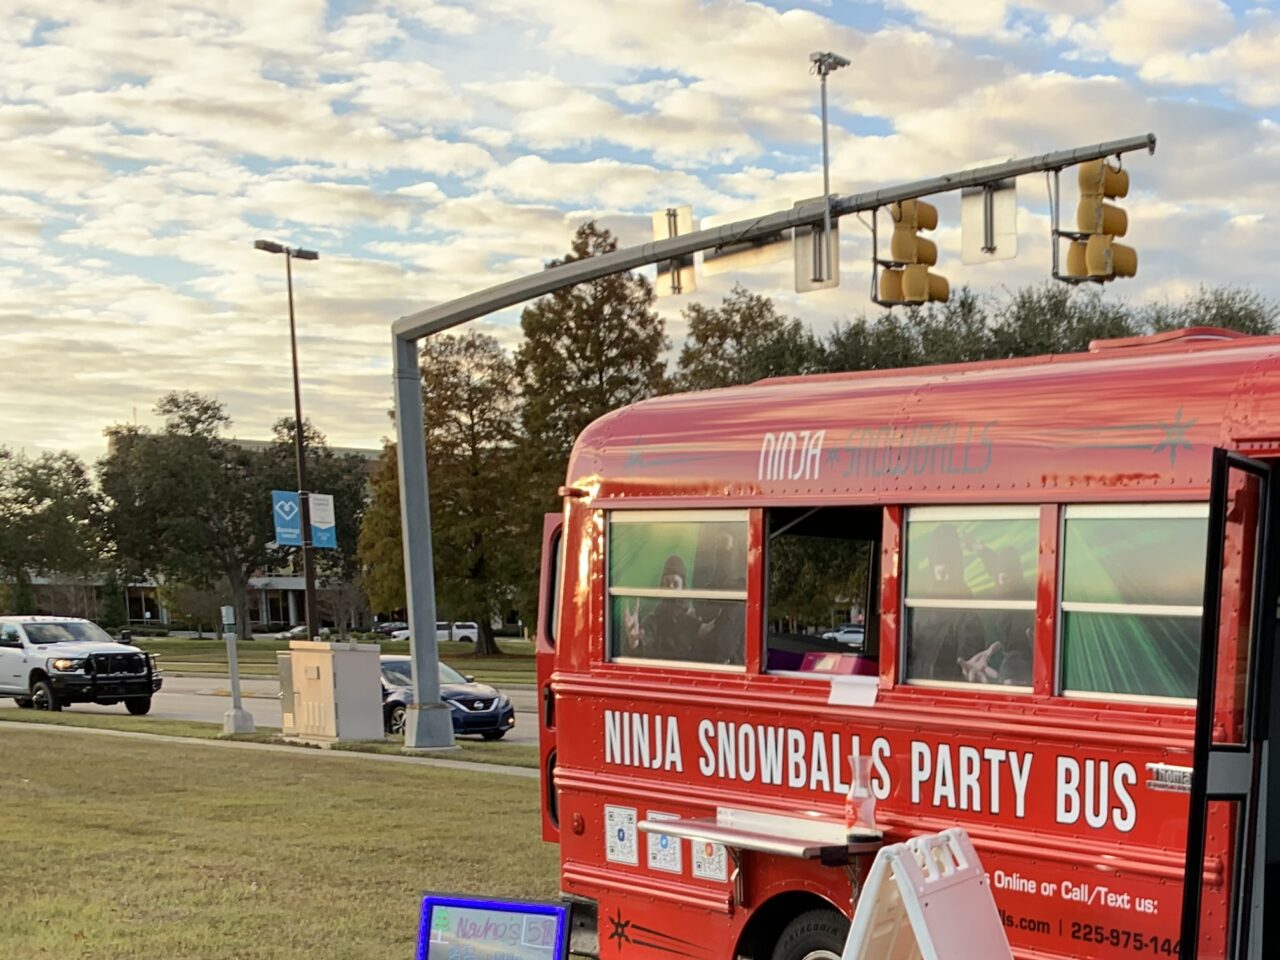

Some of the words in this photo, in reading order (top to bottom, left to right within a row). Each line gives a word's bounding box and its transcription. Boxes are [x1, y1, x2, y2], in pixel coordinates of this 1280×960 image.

[758, 429, 827, 481] NINJA
[841, 420, 998, 479] SNOWBALLS
[604, 709, 684, 773] NINJA
[698, 718, 892, 800] SNOWBALLS
[909, 740, 1034, 819] PARTY
[1055, 755, 1138, 833] BUS
[994, 870, 1037, 894] Online
[1041, 882, 1057, 896] or
[1061, 881, 1131, 909] Call/Text
[1135, 897, 1158, 914] us:
